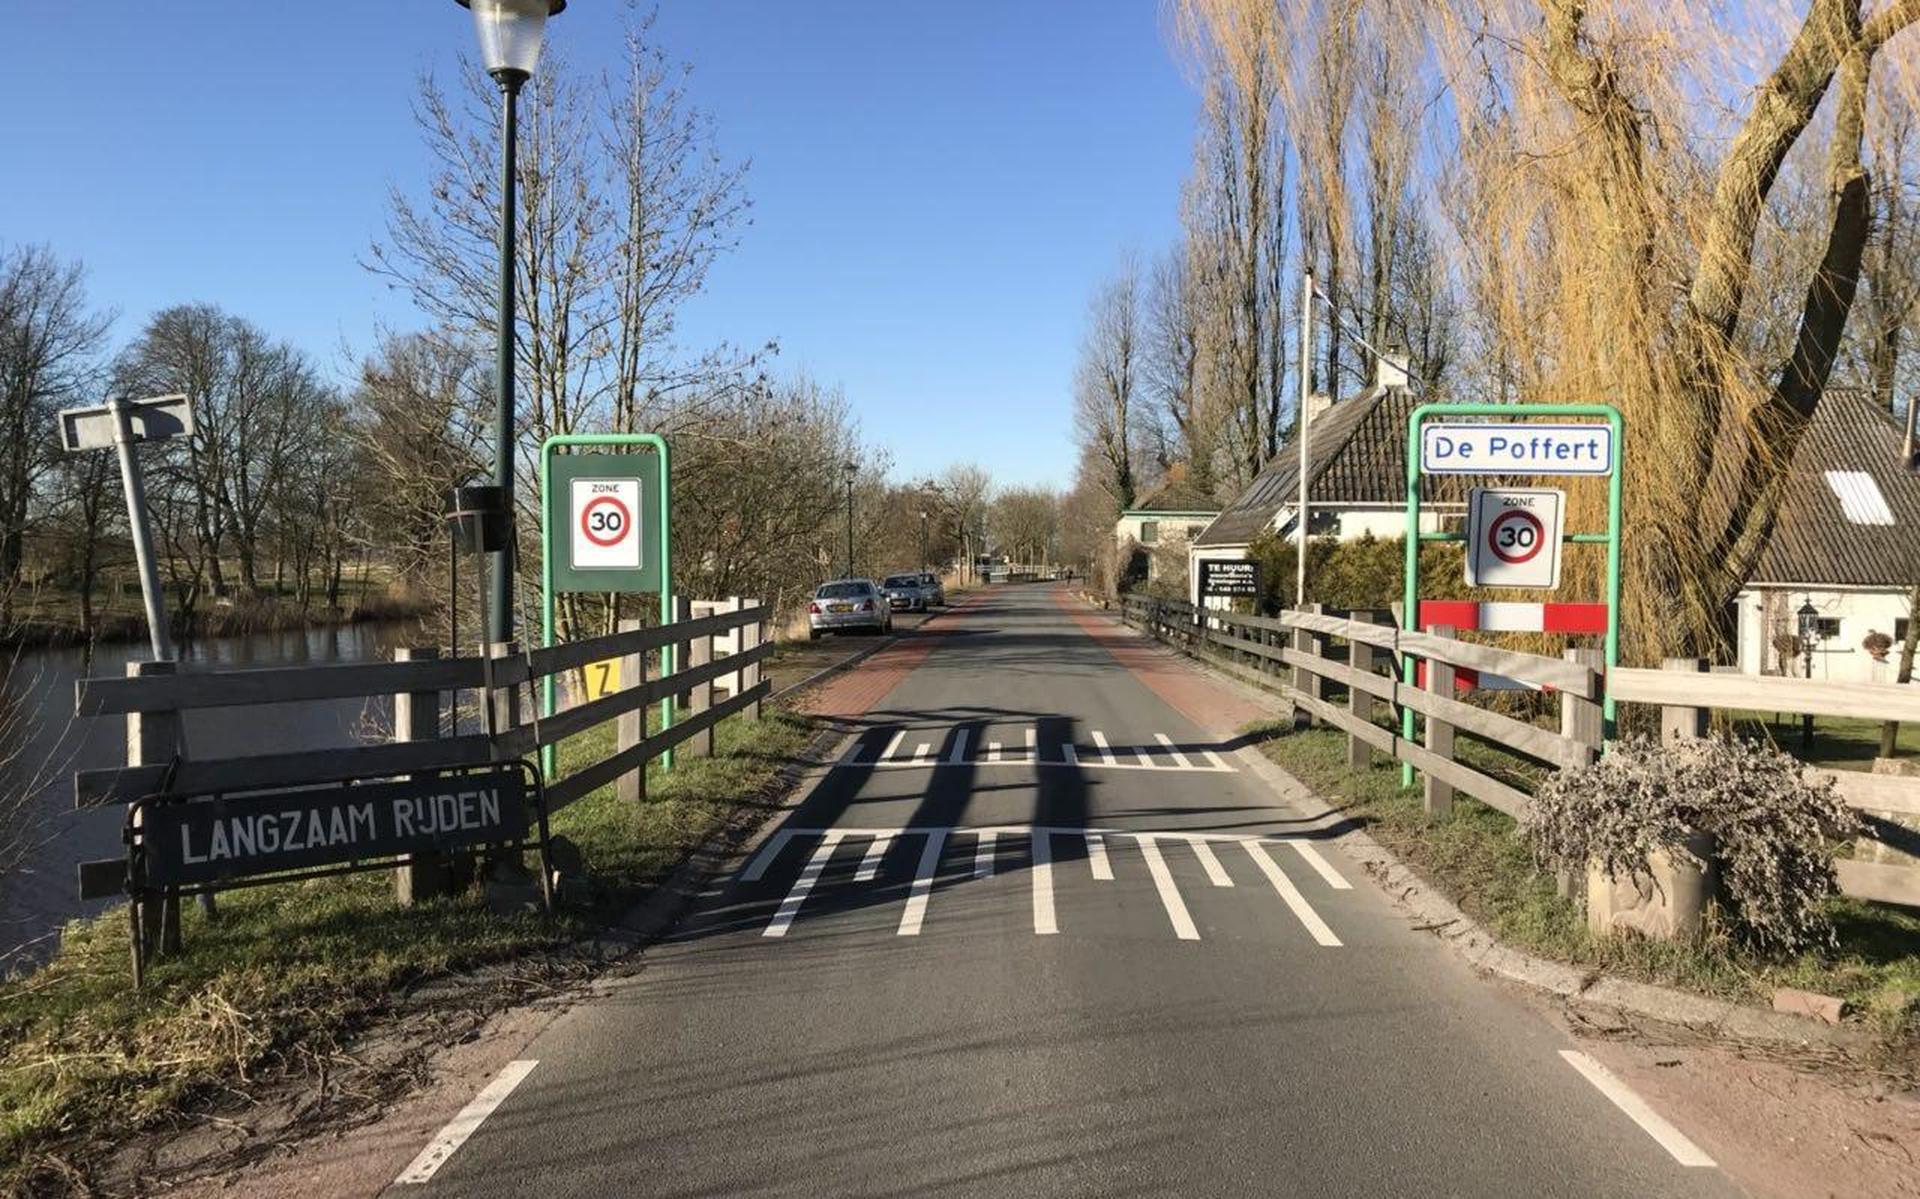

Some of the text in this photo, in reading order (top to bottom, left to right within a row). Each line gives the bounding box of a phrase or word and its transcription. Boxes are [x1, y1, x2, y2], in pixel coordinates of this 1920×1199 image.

[1435, 436, 1599, 460] De Poffert
[591, 483, 620, 493] ZONE
[1502, 497, 1536, 507] ZONE
[591, 511, 622, 532] 30
[1499, 526, 1535, 548] 30
[1207, 563, 1221, 572] TE
[181, 788, 501, 866] LANGZAAM RIJDEN
